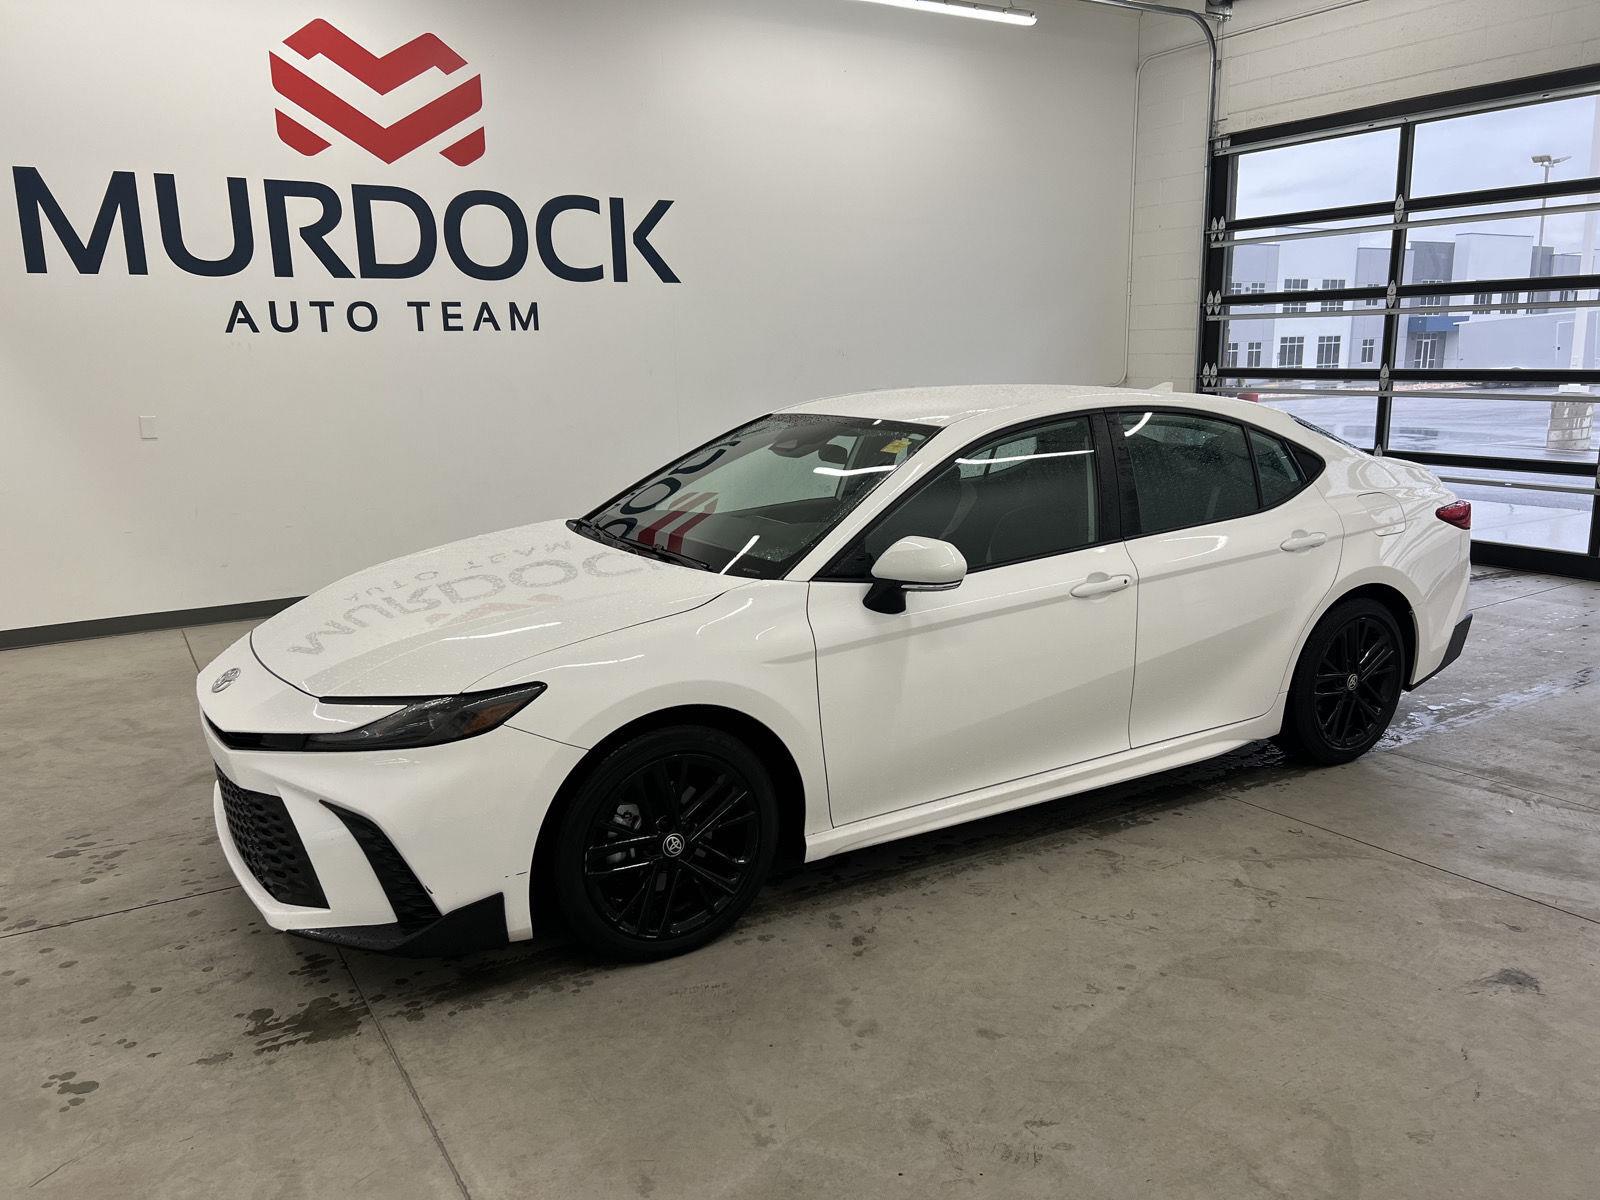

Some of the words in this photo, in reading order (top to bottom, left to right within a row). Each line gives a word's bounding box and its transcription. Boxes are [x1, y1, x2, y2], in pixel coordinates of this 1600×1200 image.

[12, 166, 681, 283] MURDOCK
[225, 300, 378, 333] AUTO
[407, 301, 540, 332] TEAM
